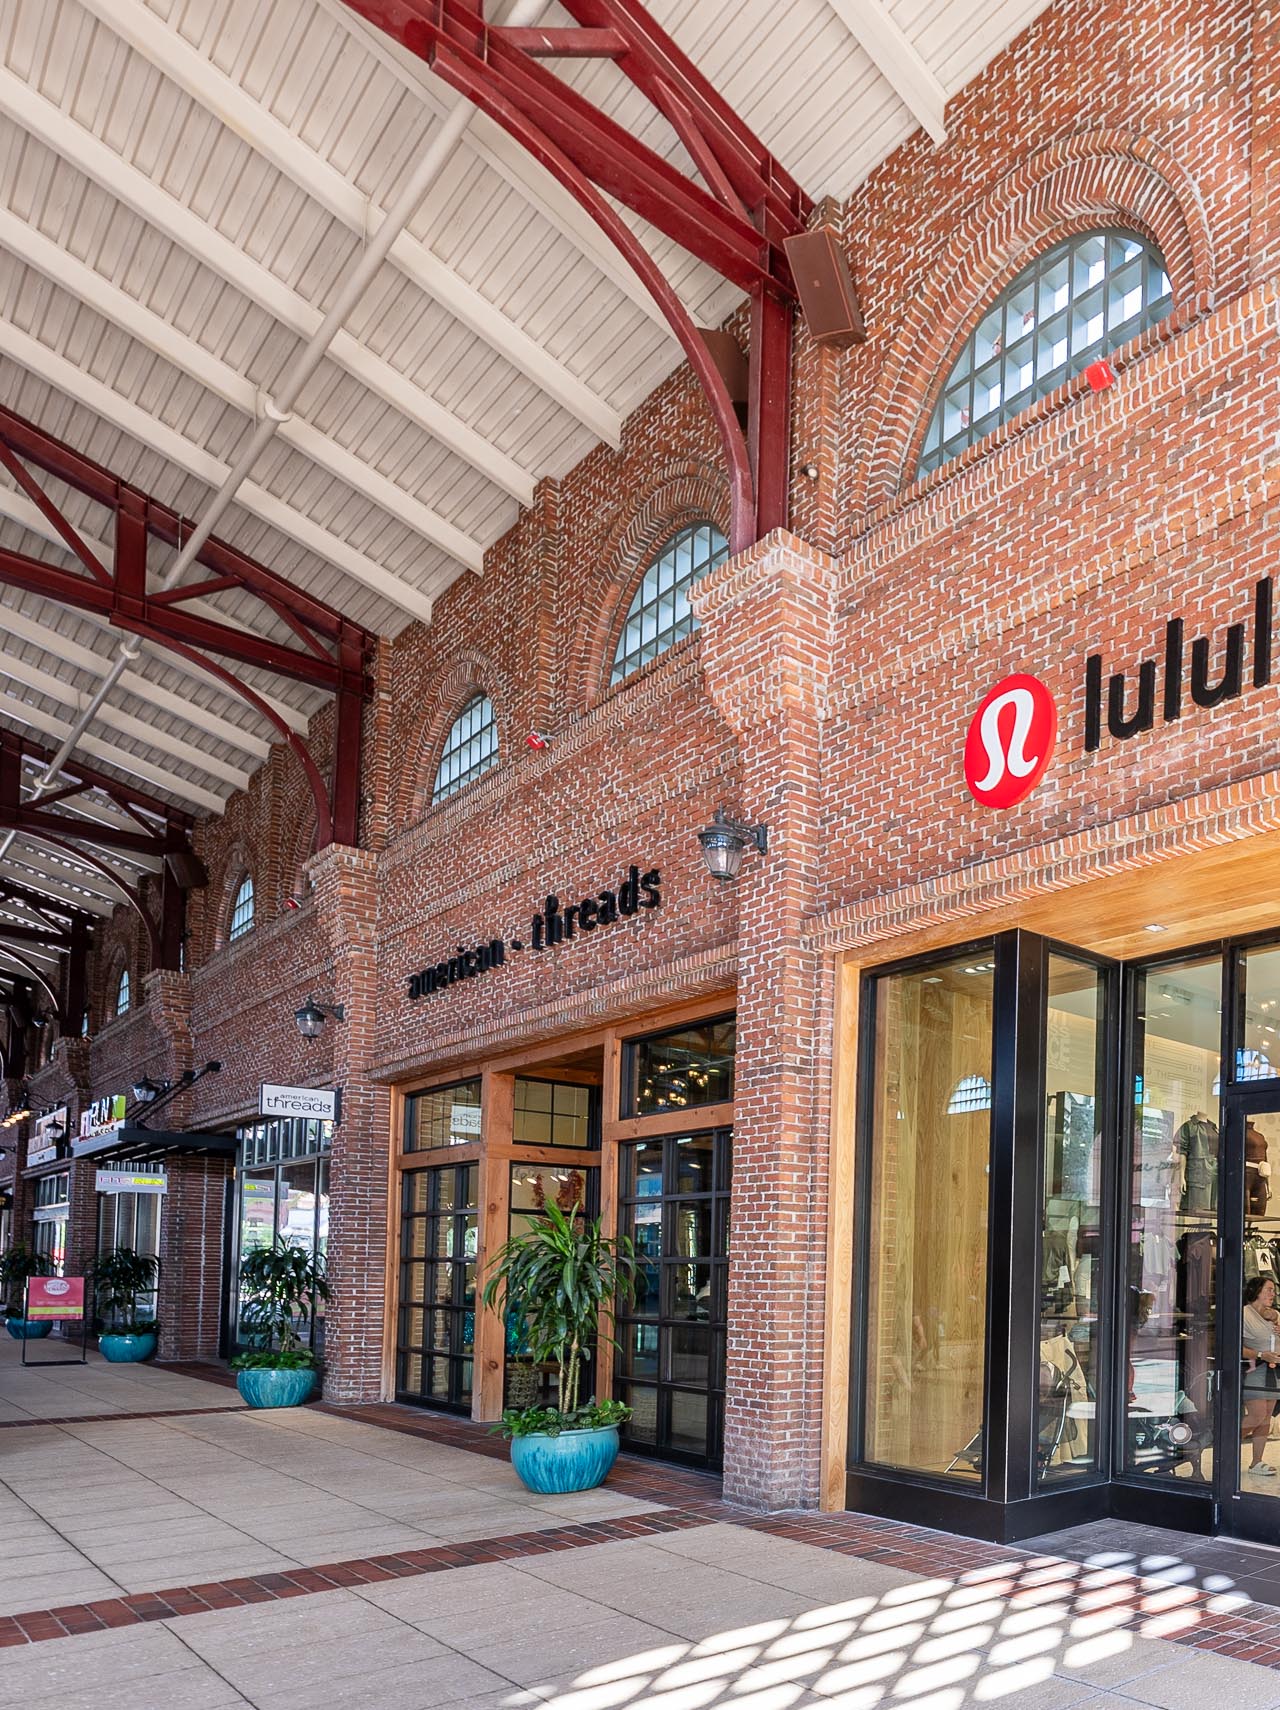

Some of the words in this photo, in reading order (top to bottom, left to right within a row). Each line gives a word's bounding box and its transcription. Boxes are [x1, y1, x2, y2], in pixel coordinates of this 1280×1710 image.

[408, 939, 504, 1000] american
[532, 864, 661, 950] threads
[266, 1096, 332, 1113] threads
[280, 1094, 320, 1103] american
